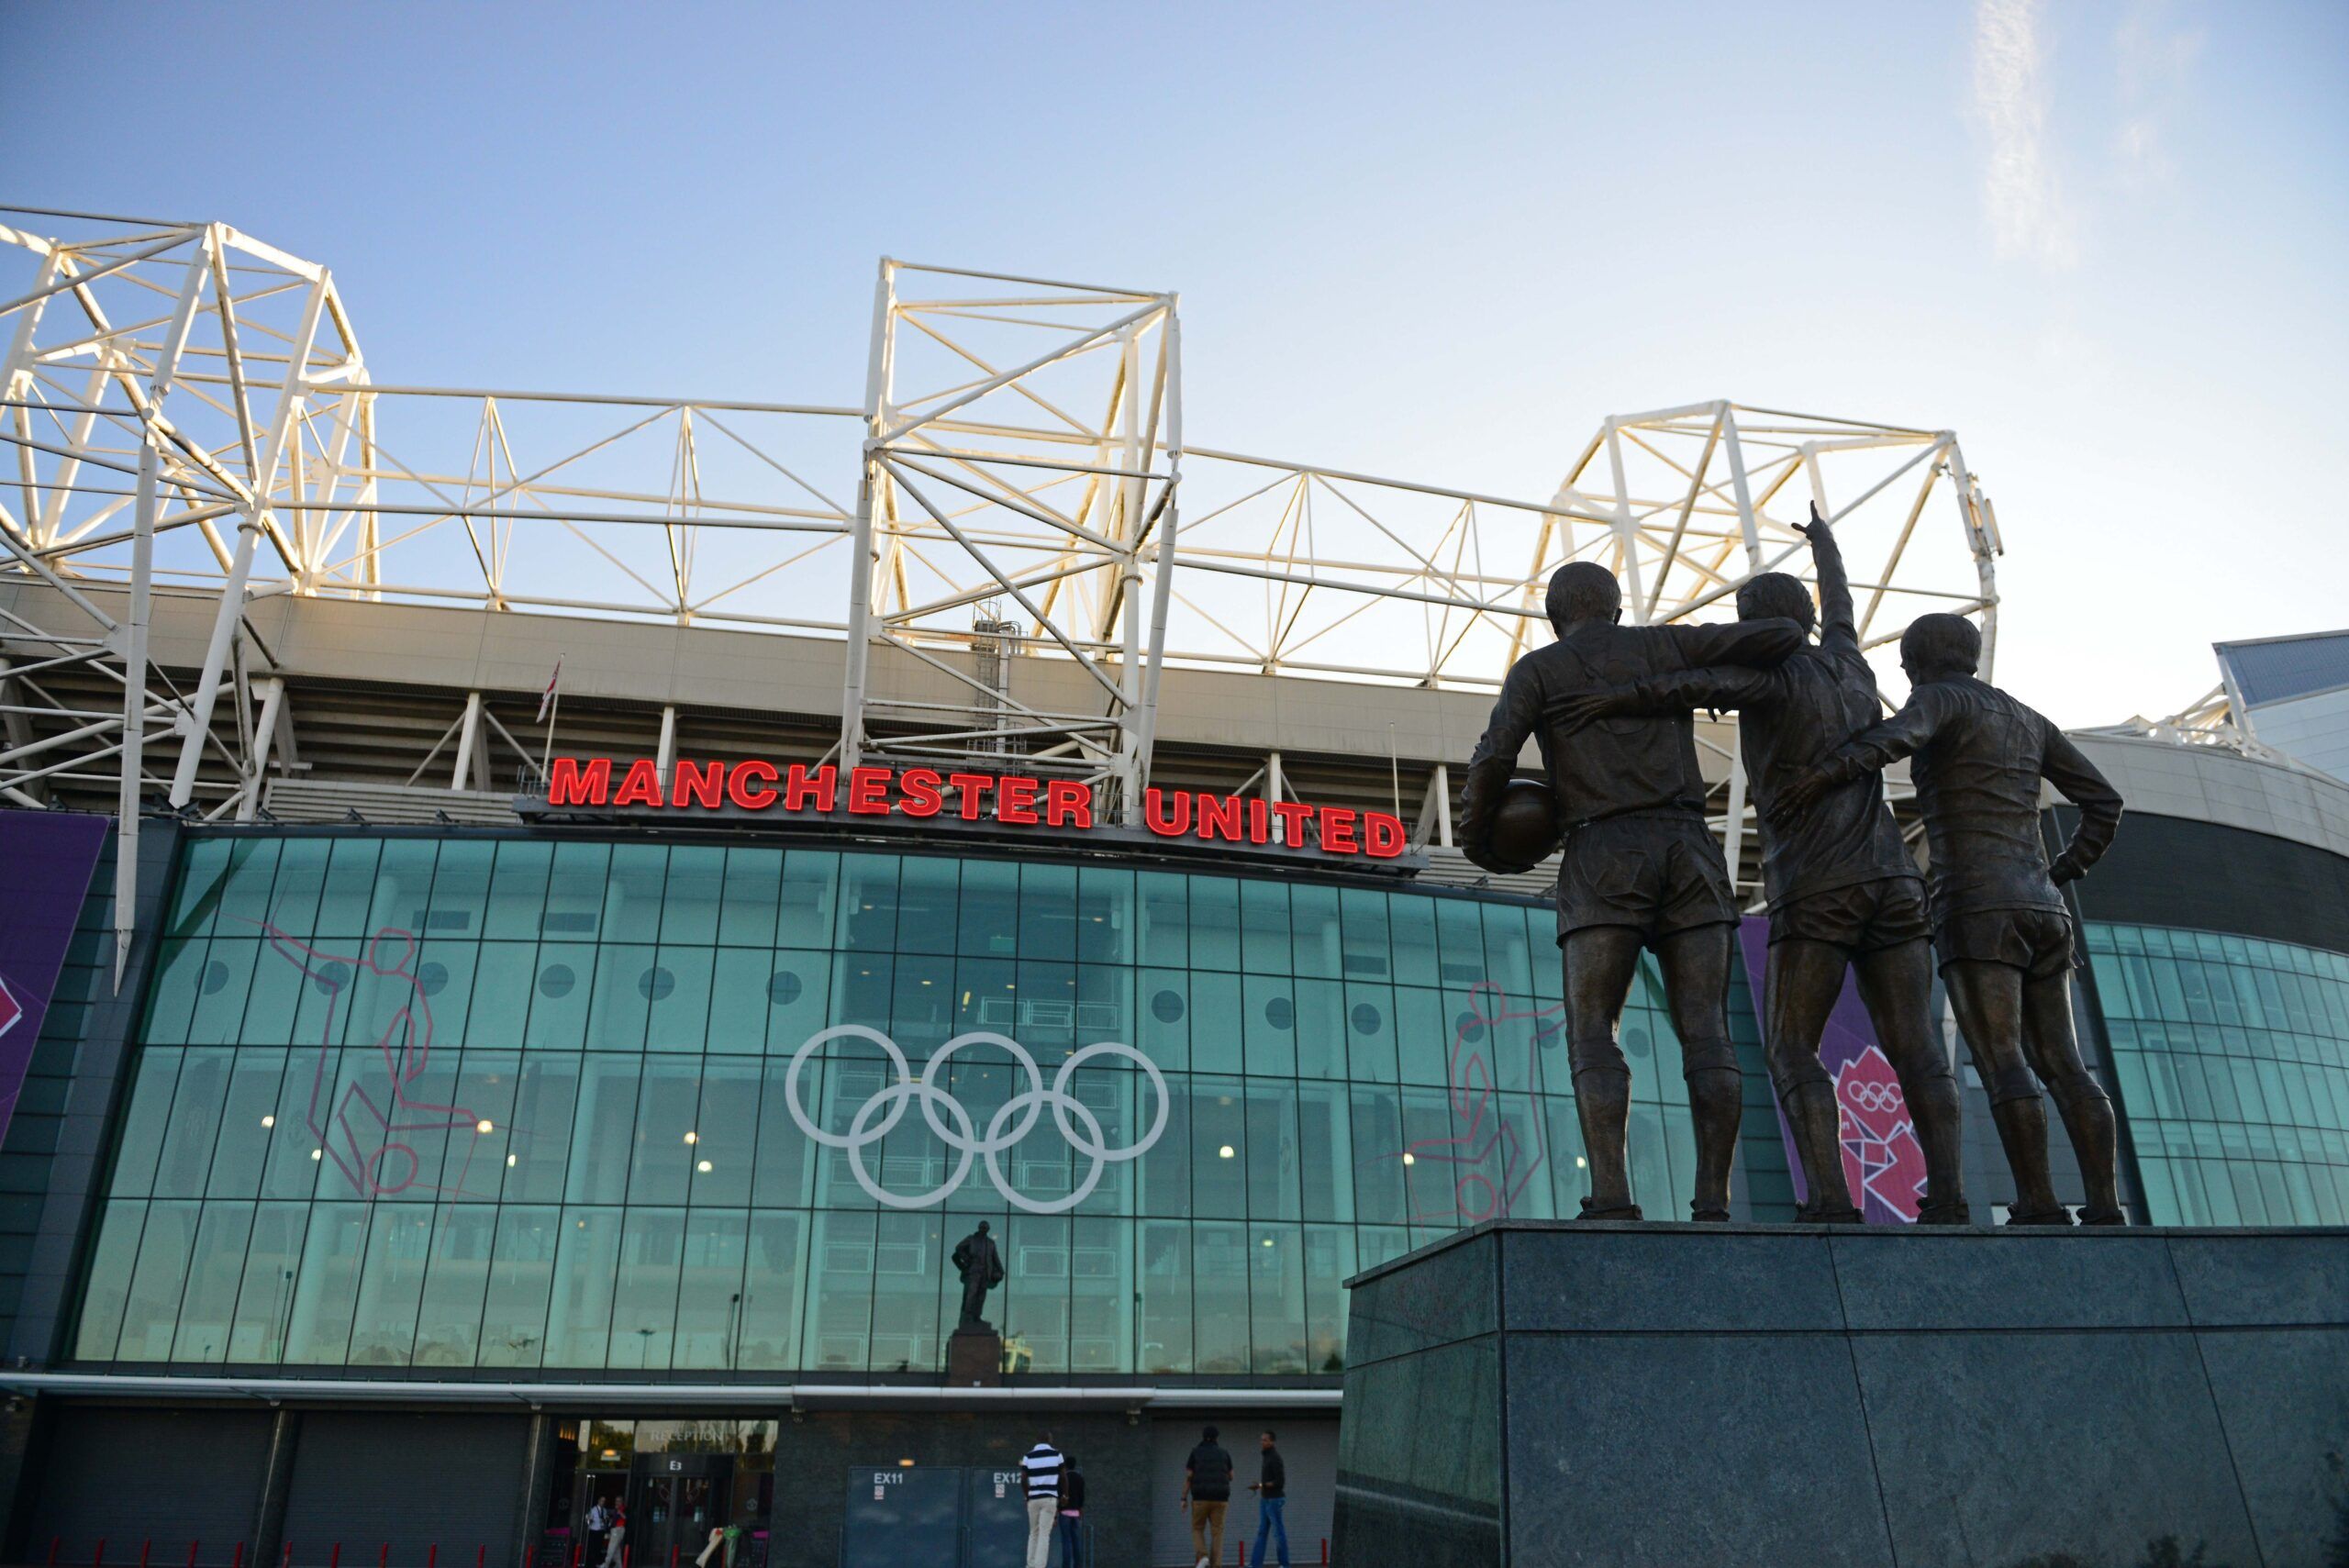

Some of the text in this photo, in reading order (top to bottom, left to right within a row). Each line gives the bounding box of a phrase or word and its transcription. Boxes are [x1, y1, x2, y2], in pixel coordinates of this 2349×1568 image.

[548, 757, 1407, 858] MANCHESTER UNITED
[651, 1429, 723, 1442] RECEPTION
[874, 1472, 903, 1485] EX11
